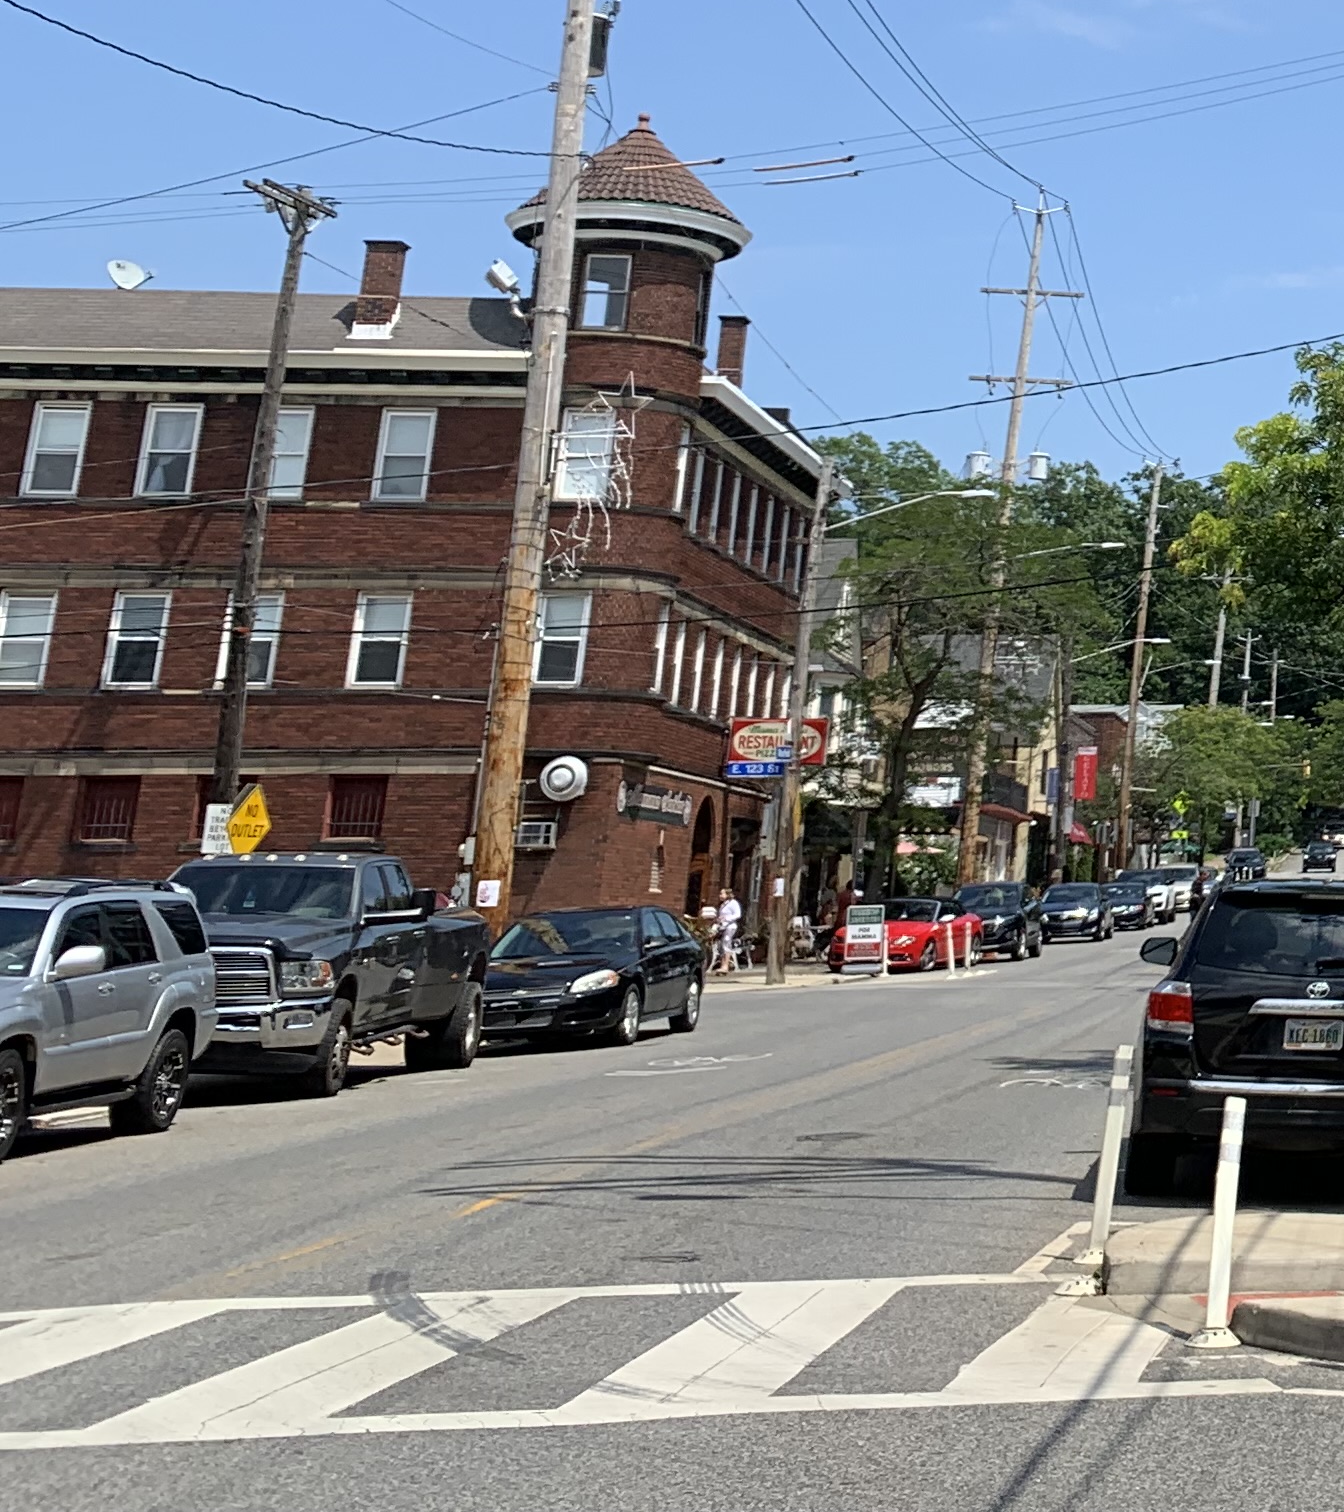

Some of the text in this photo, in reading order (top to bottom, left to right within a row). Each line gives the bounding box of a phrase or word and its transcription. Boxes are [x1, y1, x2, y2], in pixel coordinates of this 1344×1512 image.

[745, 764, 764, 774] 123
[245, 804, 259, 817] NO
[231, 823, 265, 838] OUTLET
